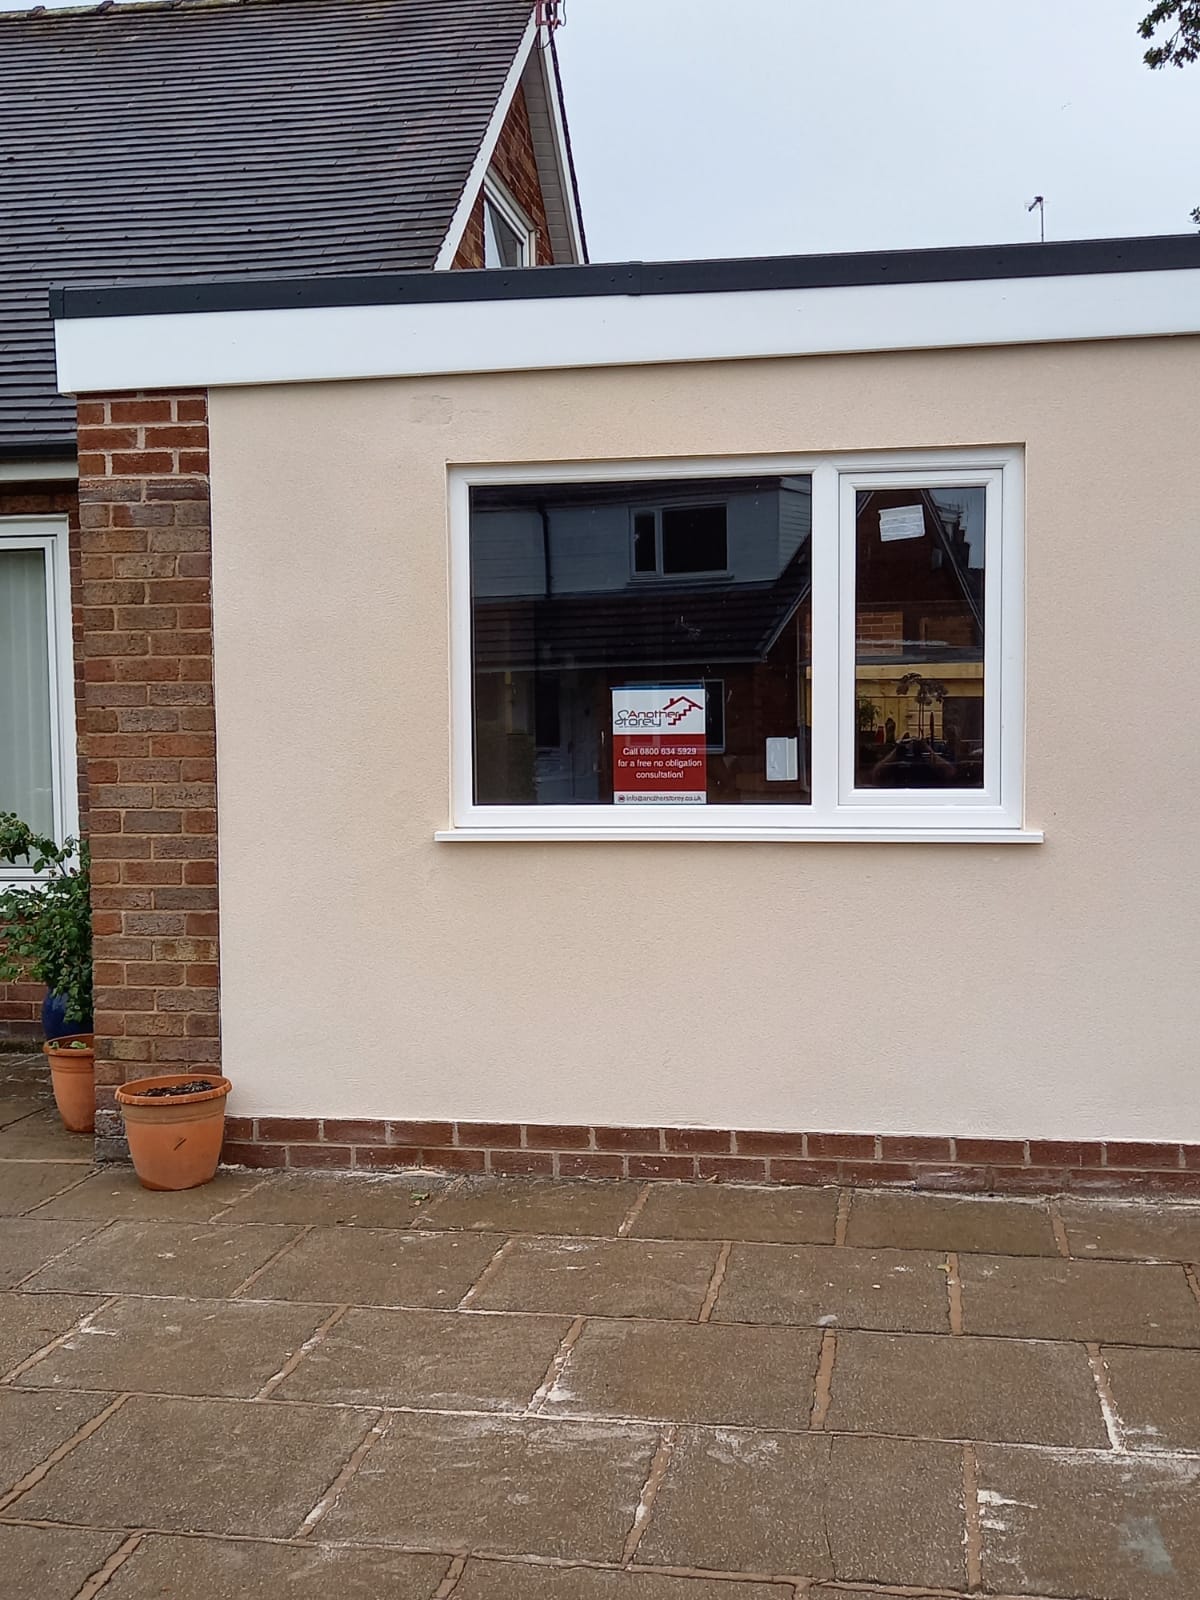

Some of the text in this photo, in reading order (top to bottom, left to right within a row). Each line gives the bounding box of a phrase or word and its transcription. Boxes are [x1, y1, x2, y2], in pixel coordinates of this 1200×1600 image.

[614, 709, 662, 727] Storey
[628, 710, 679, 719] Another
[622, 747, 638, 755] Call
[617, 759, 628, 767] for
[637, 759, 652, 767] free
[665, 759, 702, 768] obligation
[635, 770, 684, 778] consultation!
